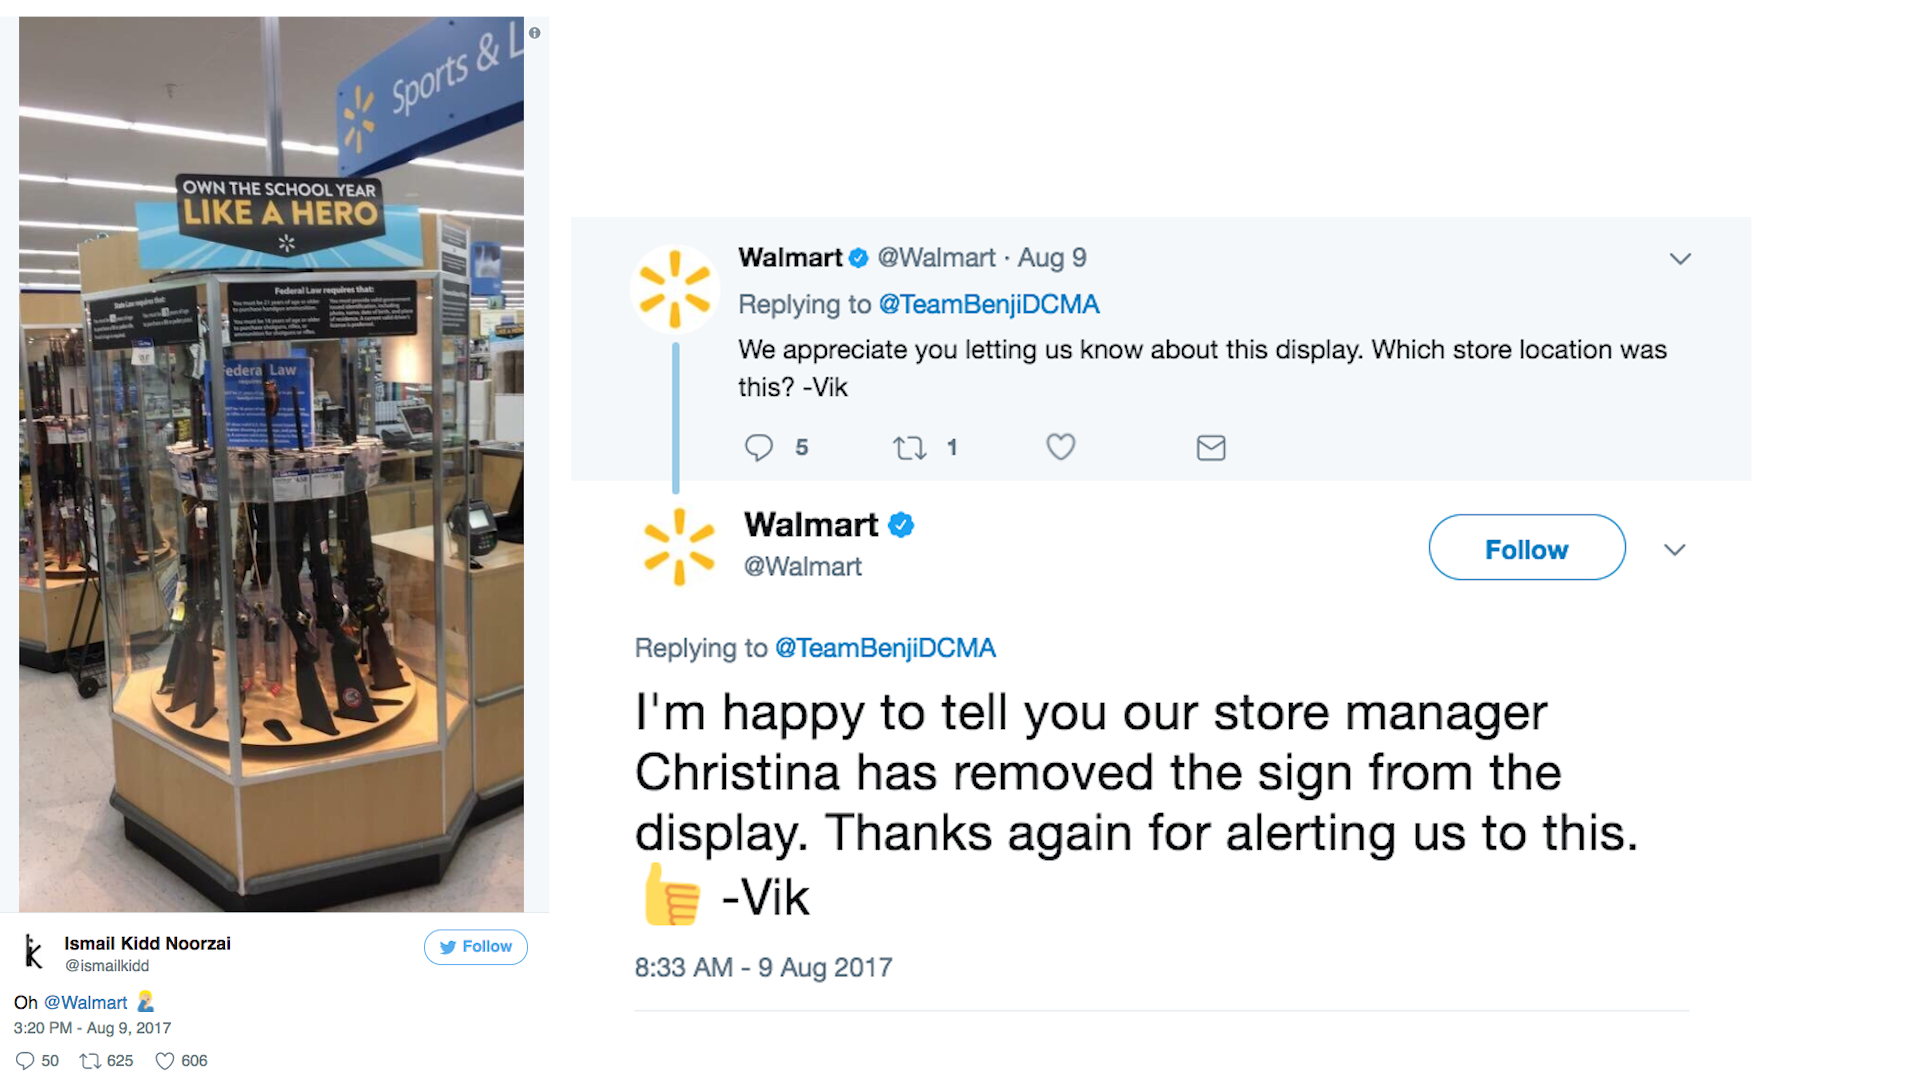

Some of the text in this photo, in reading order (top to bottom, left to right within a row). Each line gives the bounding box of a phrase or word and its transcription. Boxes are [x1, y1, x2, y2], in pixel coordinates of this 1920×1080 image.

[393, 53, 468, 117] Sports
[476, 32, 499, 72] &
[183, 180, 376, 198] OWN THE SCHOOL YEAR
[184, 198, 379, 226] LIKE A HERO
[275, 285, 375, 295] Federal Law requires that:
[223, 364, 297, 377] edera Law
